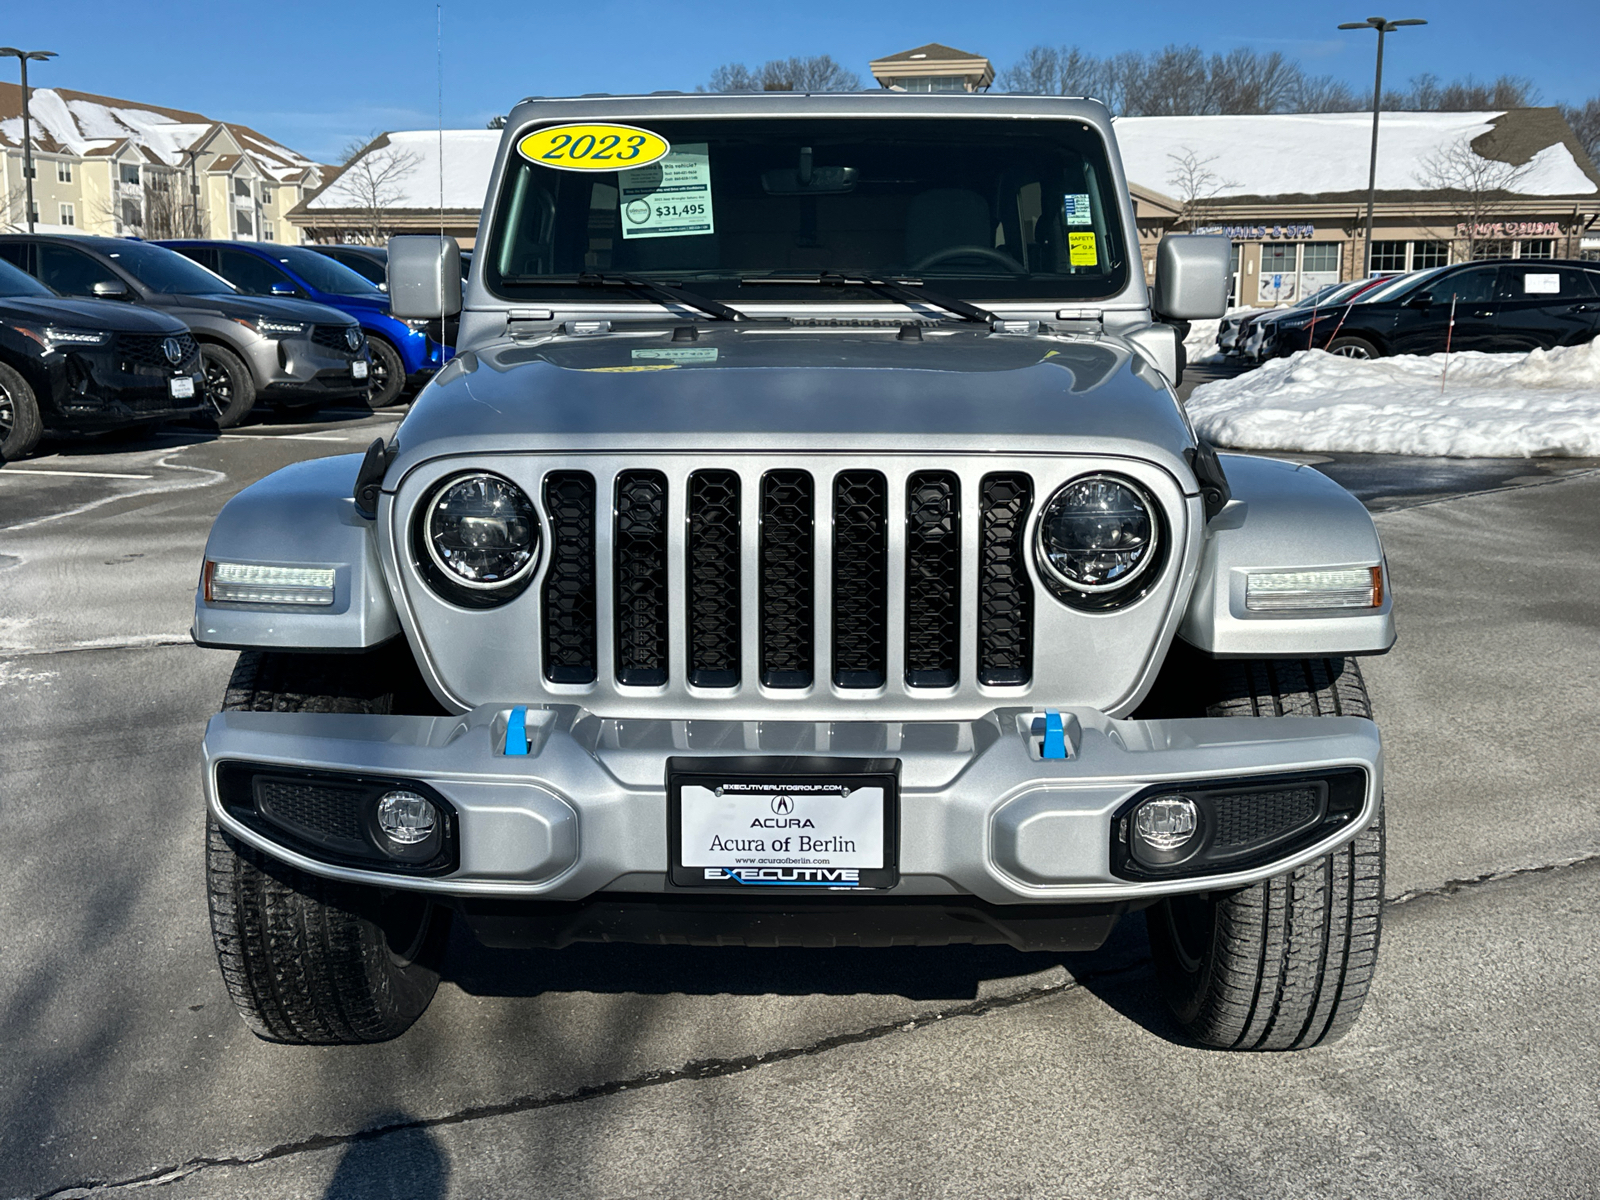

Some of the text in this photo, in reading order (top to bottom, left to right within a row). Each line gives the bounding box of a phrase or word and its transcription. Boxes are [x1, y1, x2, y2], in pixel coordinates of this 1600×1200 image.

[541, 134, 647, 160] 2023
[655, 204, 705, 218] $31,495
[1223, 223, 1266, 238] NAILS
[1273, 223, 1282, 237] &
[1287, 222, 1315, 237] SPA
[750, 818, 815, 829] ACURA
[709, 834, 857, 853] Acura of Berlin
[734, 857, 831, 865] www.acuraofberlin.com
[704, 868, 860, 881] EXECUTIVE
